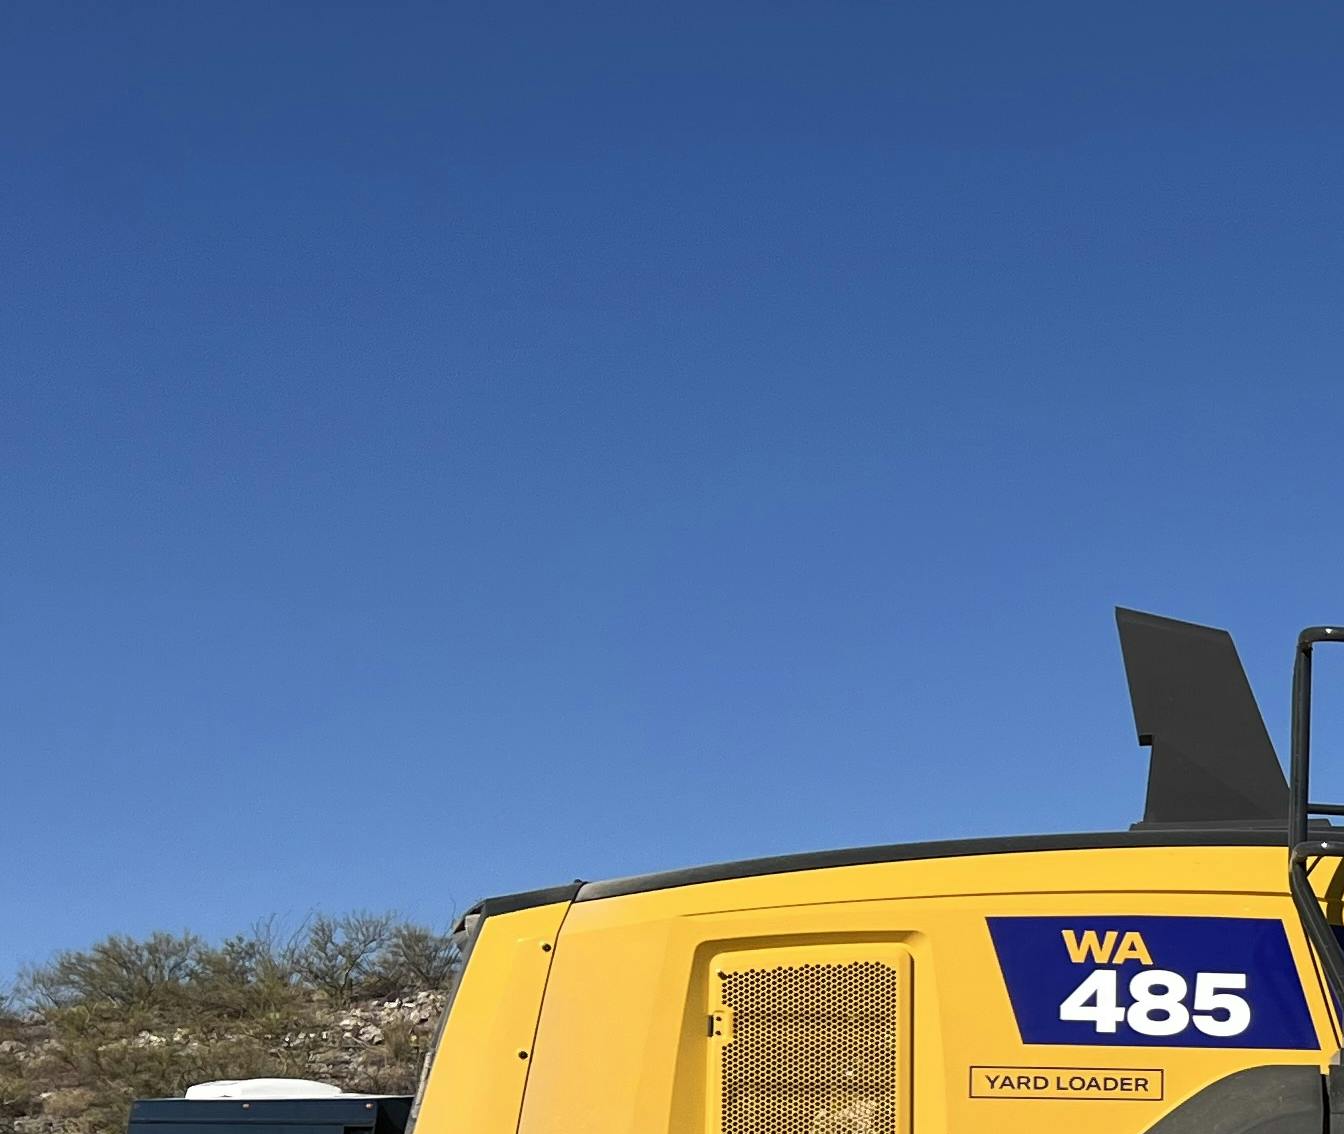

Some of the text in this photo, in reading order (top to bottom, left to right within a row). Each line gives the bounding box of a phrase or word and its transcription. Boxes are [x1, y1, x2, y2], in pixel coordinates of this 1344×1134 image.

[1061, 929, 1154, 965] WA
[1059, 969, 1251, 1037] 485
[985, 1074, 1149, 1093] YARD LOADER
